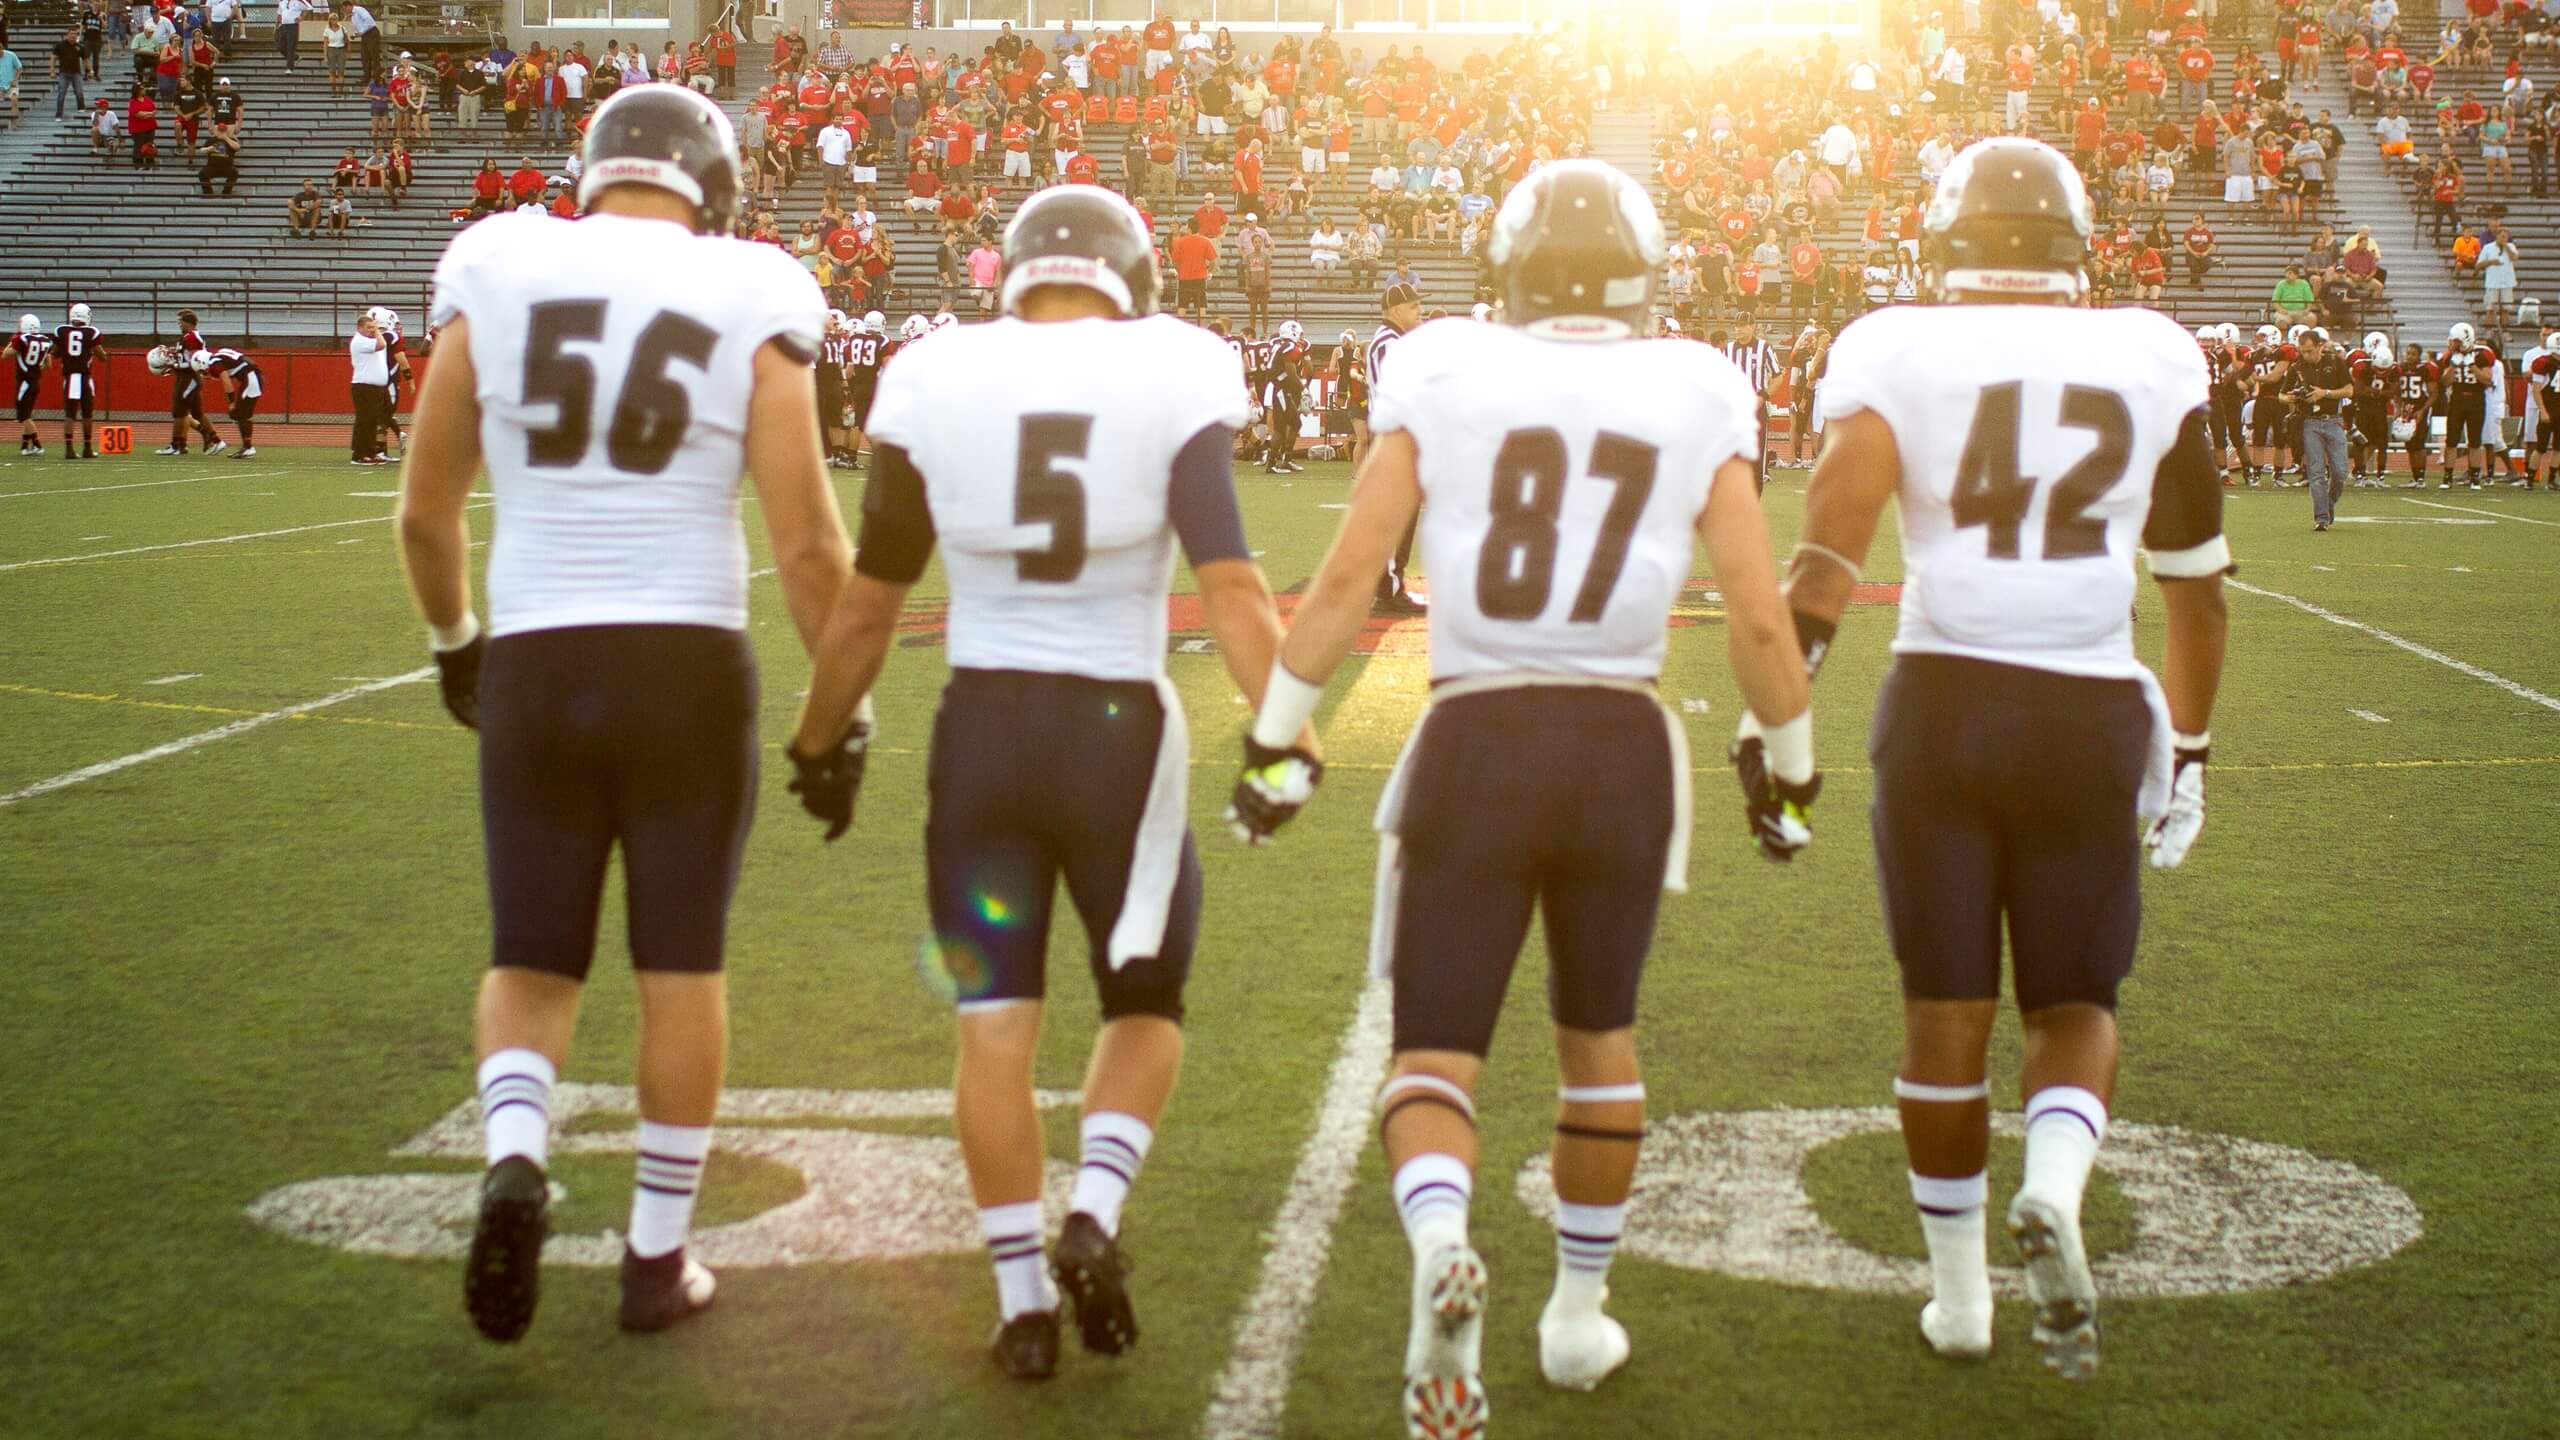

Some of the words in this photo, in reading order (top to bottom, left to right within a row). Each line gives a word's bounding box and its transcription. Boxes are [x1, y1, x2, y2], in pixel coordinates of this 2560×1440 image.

[68, 330, 83, 357] 6
[520, 298, 720, 476] 56
[851, 338, 876, 366] 83
[2400, 375, 2422, 399] 25
[104, 427, 130, 451] 30
[1949, 383, 2134, 561] 42
[1010, 413, 1091, 585] 5
[1476, 427, 1659, 625] 87
